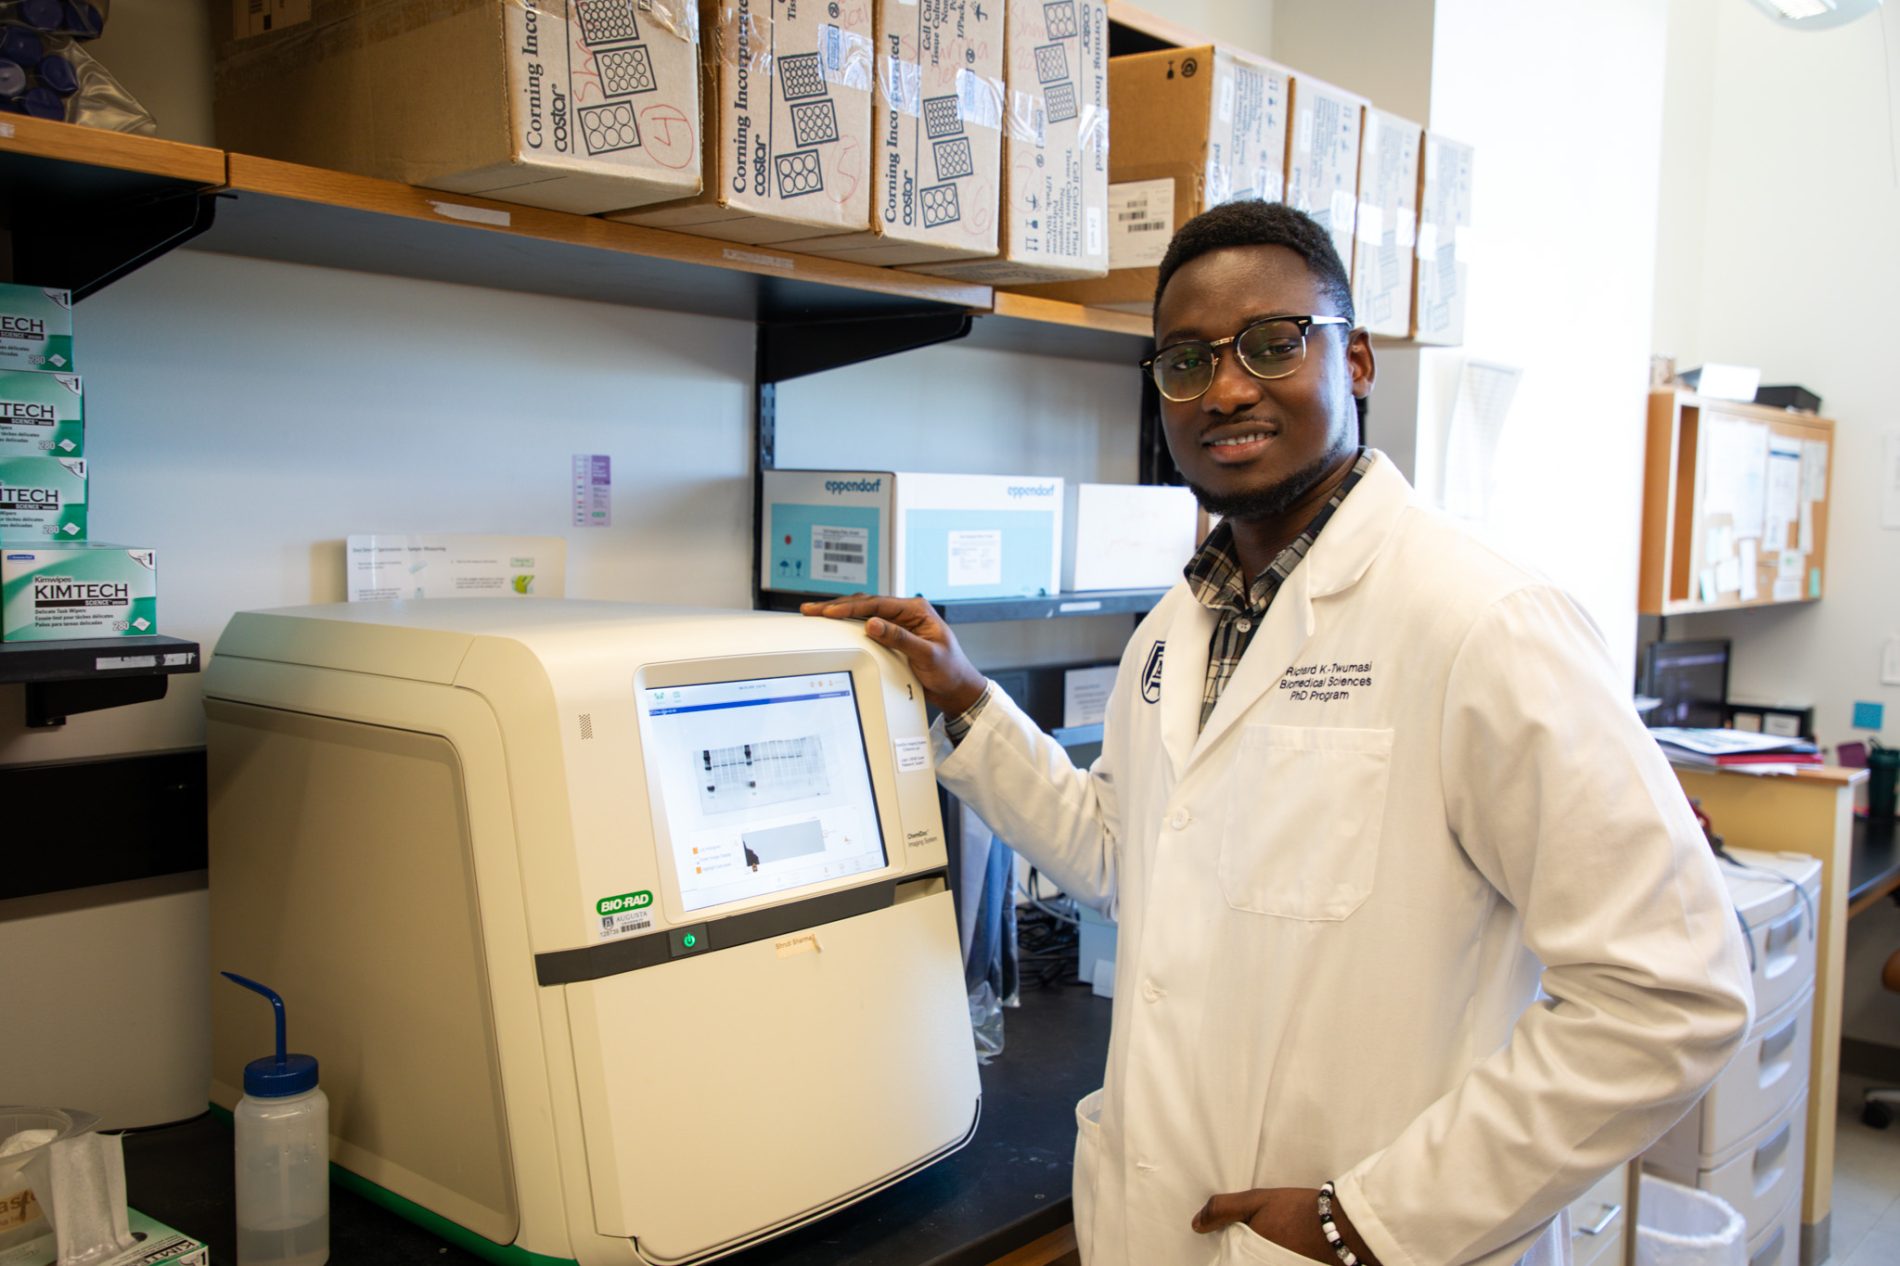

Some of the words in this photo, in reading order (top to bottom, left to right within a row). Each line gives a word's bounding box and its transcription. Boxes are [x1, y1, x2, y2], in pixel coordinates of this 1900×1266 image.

[522, 0, 539, 57] Incor
[1093, 7, 1105, 70] Corning
[526, 62, 544, 150] Corning
[732, 115, 751, 194] Corning
[884, 150, 901, 224] Corning
[0, 316, 44, 333] ECH
[825, 478, 881, 496] eppendorf
[1007, 484, 1056, 500] eppendorf
[35, 583, 128, 600] KIMTECH
[1279, 677, 1326, 690] Biomedical
[1327, 676, 1373, 688] Sciences
[1290, 690, 1308, 701] PhD
[1309, 690, 1350, 702] Program
[600, 893, 650, 913] BIO-RAD
[616, 911, 648, 923] AUGUSTA
